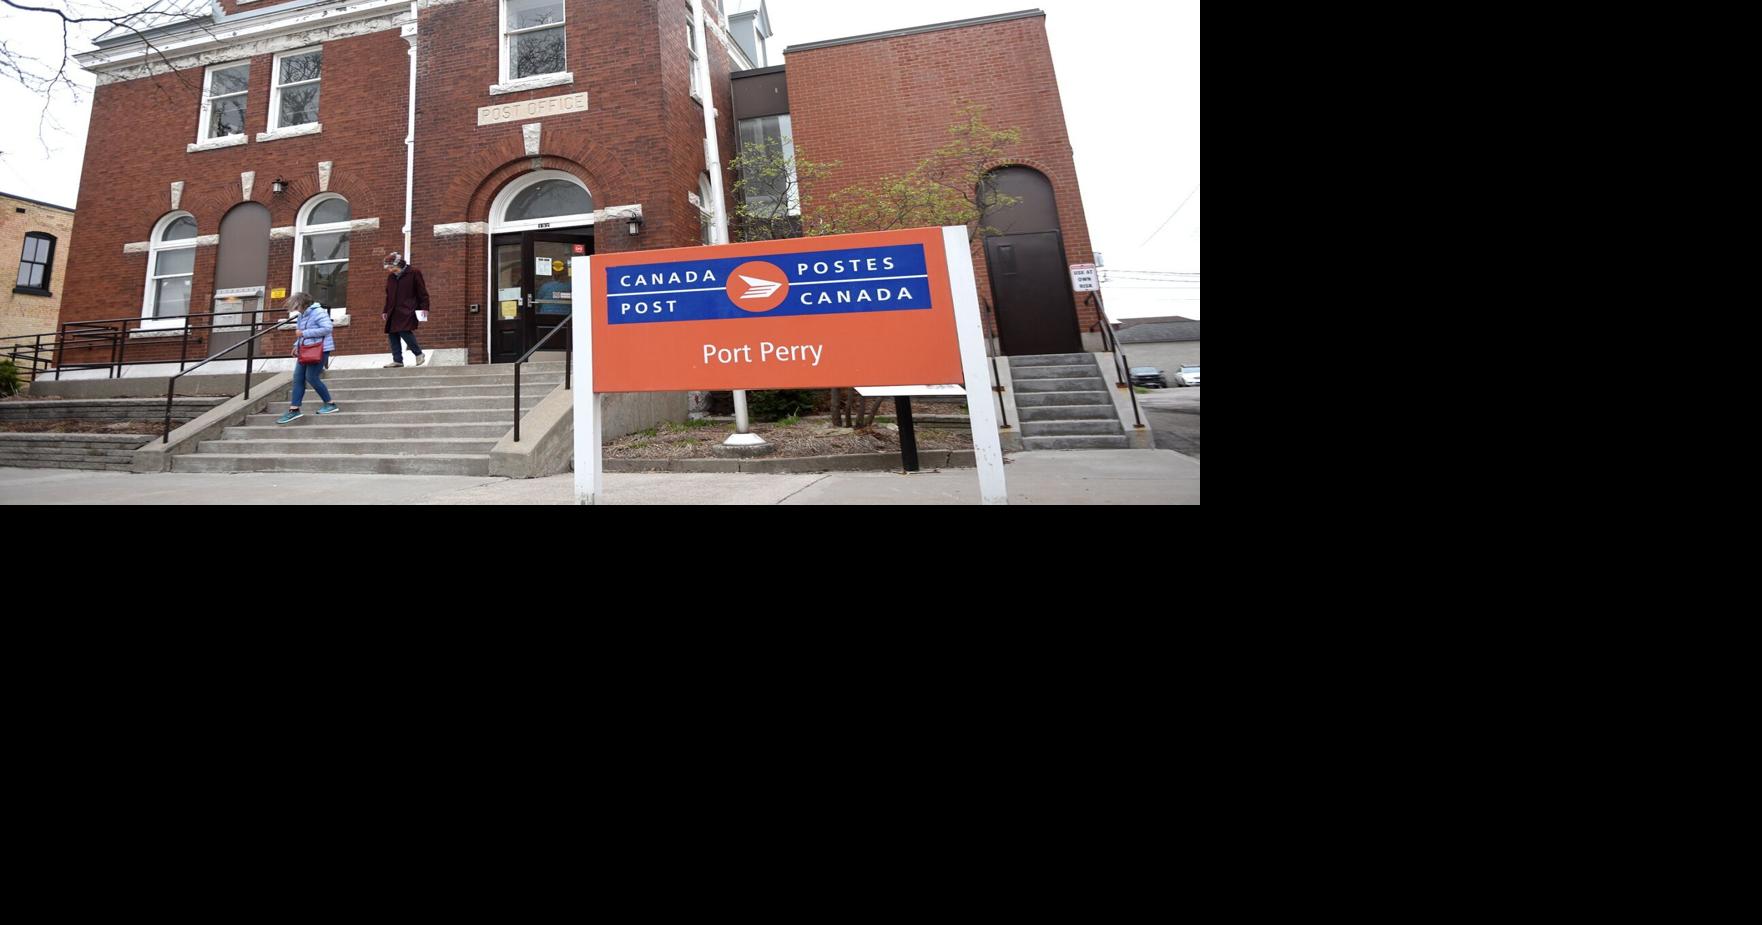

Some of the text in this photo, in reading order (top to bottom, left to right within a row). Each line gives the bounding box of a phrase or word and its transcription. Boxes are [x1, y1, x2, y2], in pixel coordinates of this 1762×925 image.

[482, 94, 585, 121] POST OFFICE
[797, 257, 895, 275] POSTES
[620, 269, 716, 287] CANADA
[800, 287, 913, 305] CANADA
[621, 300, 677, 315] POST
[703, 342, 823, 367] Port Perry
